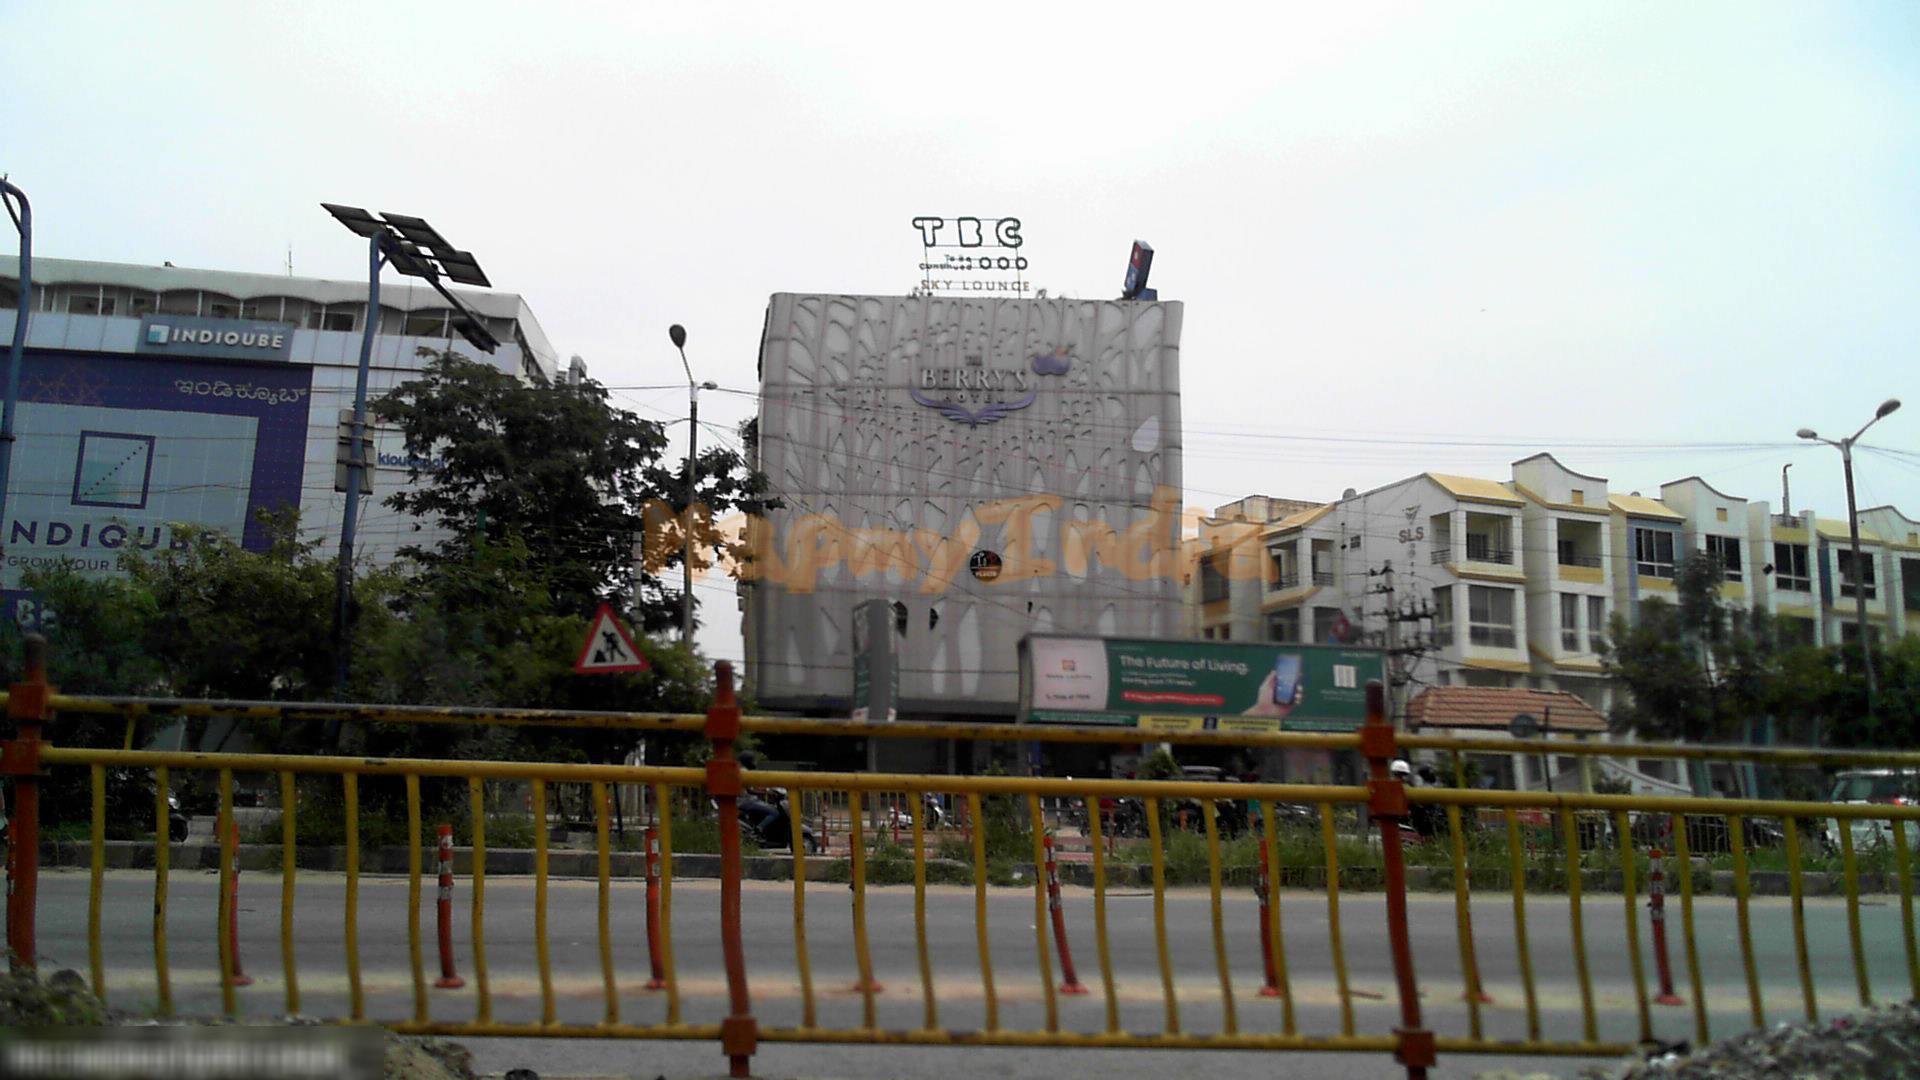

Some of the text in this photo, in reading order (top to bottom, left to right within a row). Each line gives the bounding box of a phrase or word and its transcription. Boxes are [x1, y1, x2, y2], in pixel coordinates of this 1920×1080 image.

[912, 216, 1023, 248] TBC
[920, 279, 952, 290] SKY
[171, 328, 284, 348] INDIQUBE
[1399, 526, 1424, 544] SLS
[1120, 655, 1144, 667] The
[1146, 657, 1190, 670] Future
[1191, 660, 1206, 671] of
